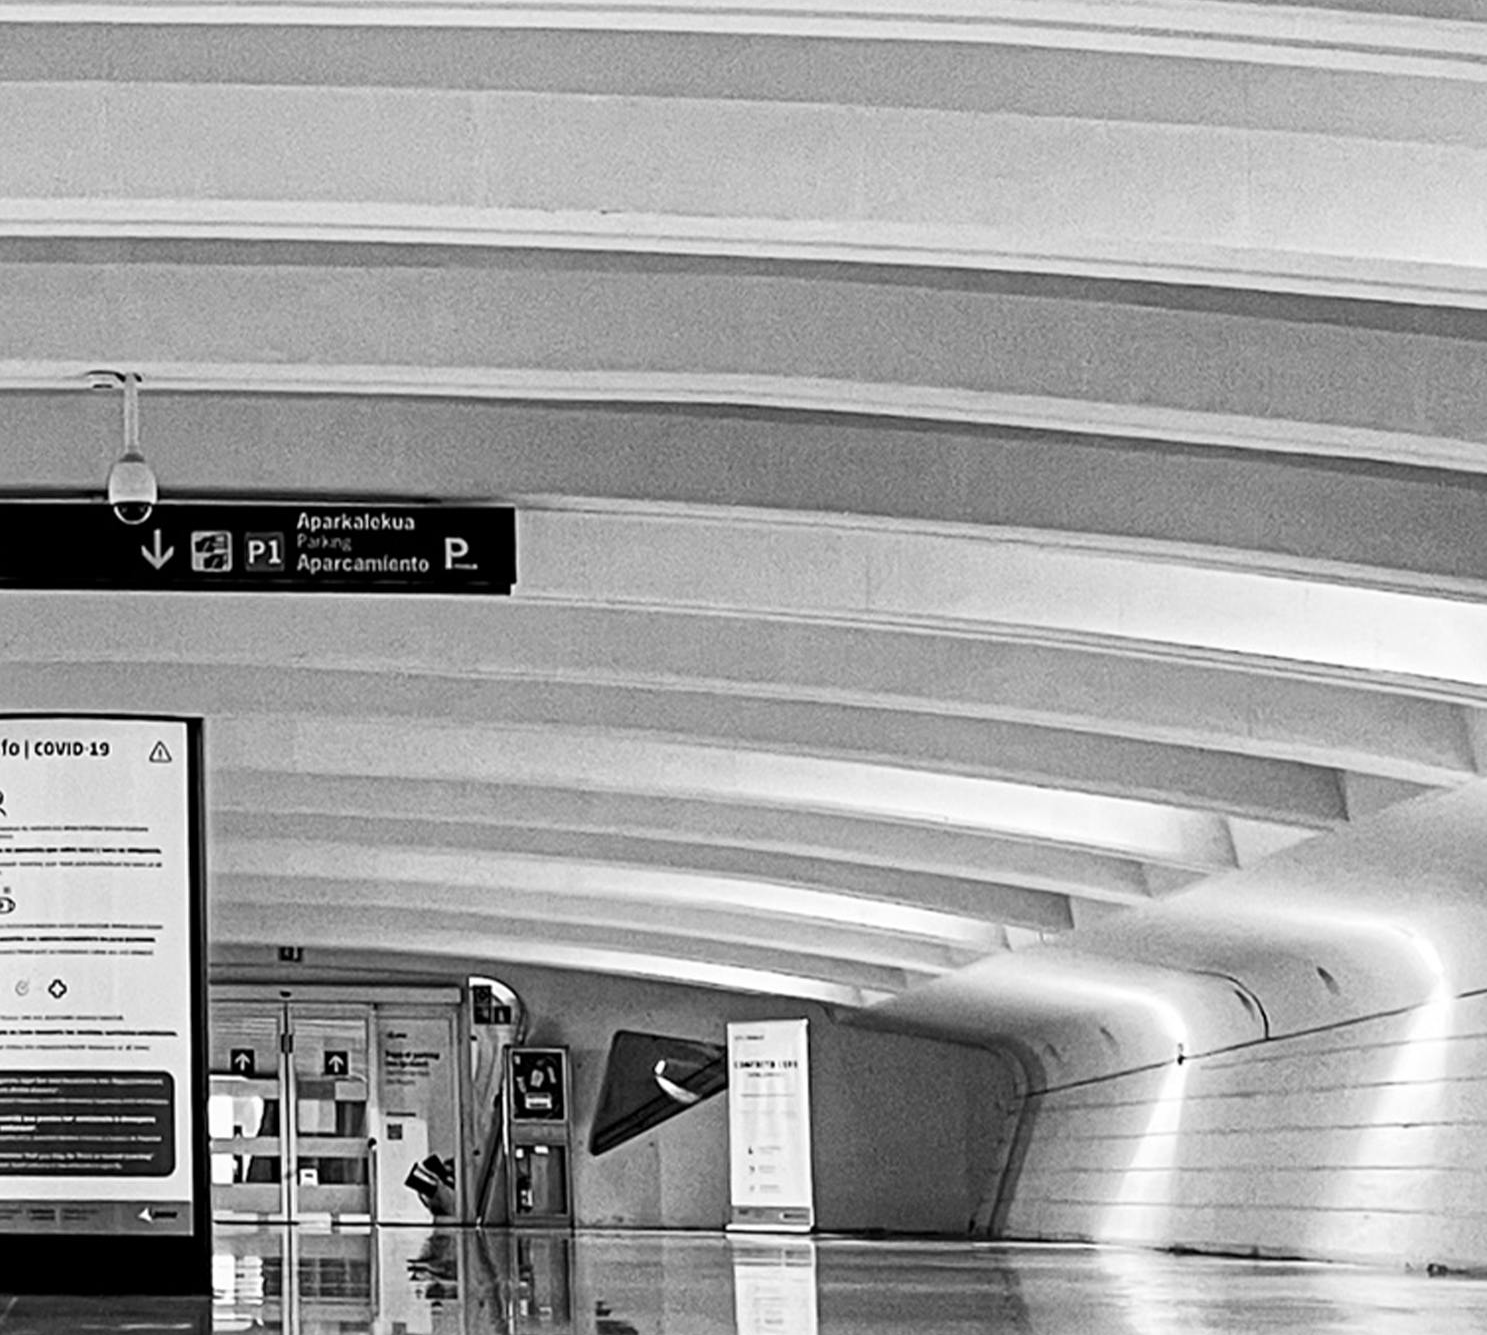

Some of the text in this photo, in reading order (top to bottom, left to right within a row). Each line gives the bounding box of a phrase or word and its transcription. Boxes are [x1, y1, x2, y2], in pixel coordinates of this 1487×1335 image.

[297, 512, 415, 532] Aparkalekua
[248, 540, 281, 564] P1
[297, 533, 352, 552] Parking
[297, 553, 430, 575] Aparcamiento
